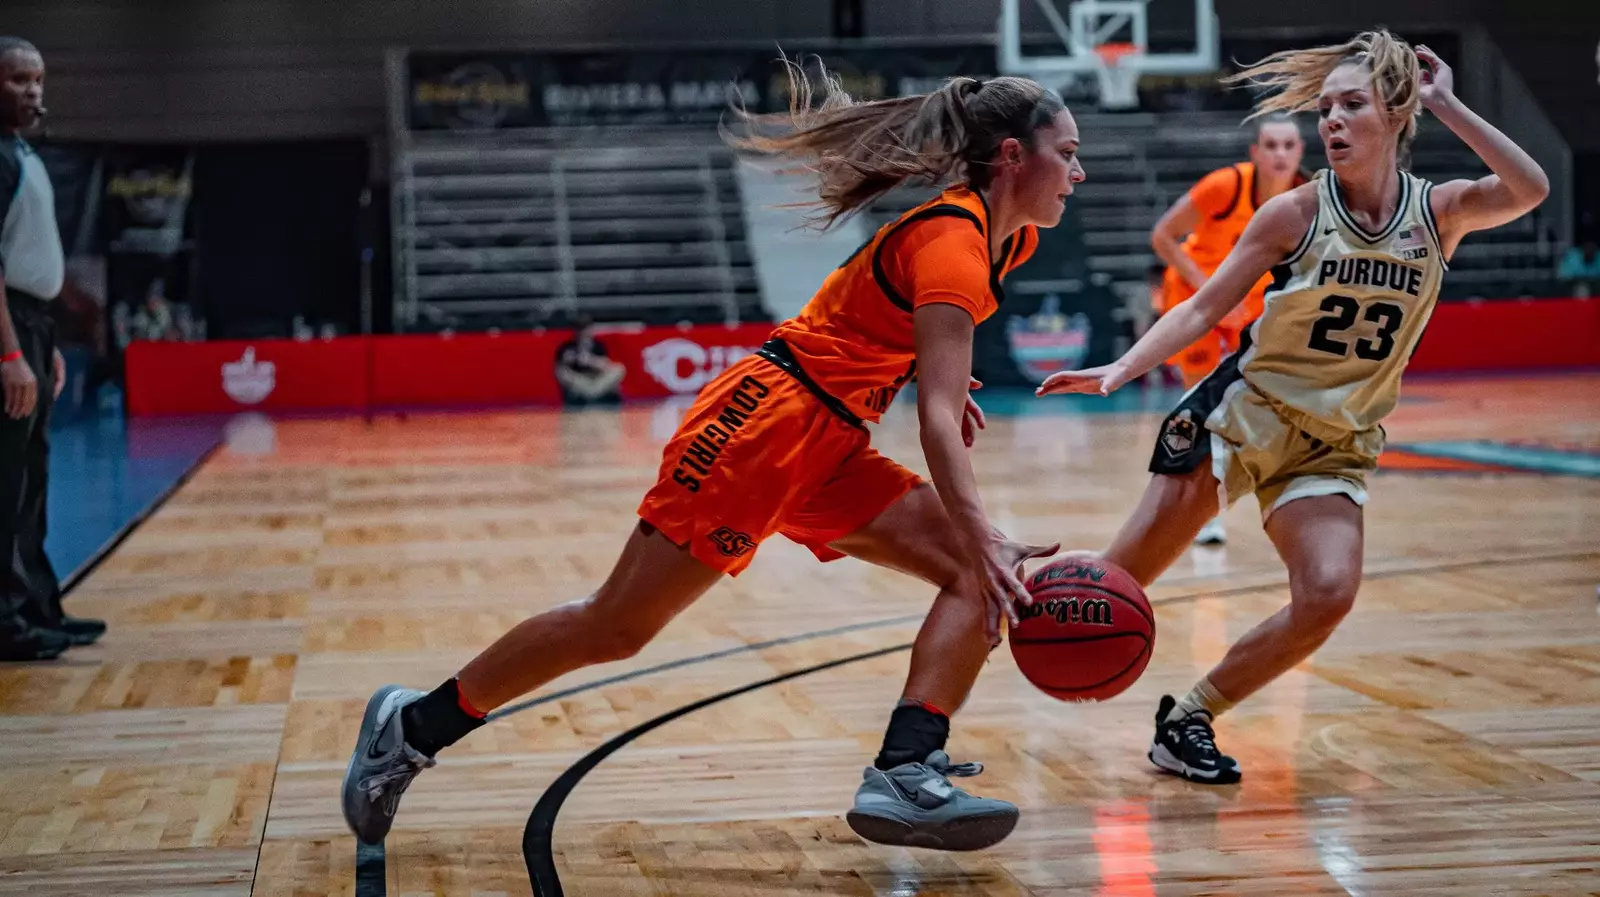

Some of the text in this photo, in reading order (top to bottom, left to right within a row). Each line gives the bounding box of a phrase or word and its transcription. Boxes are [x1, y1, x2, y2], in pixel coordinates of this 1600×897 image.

[1318, 258, 1423, 296] PURDUE
[1307, 294, 1404, 361] 23
[672, 374, 769, 493] COWGIRLS
[1018, 597, 1114, 626] Wilson
